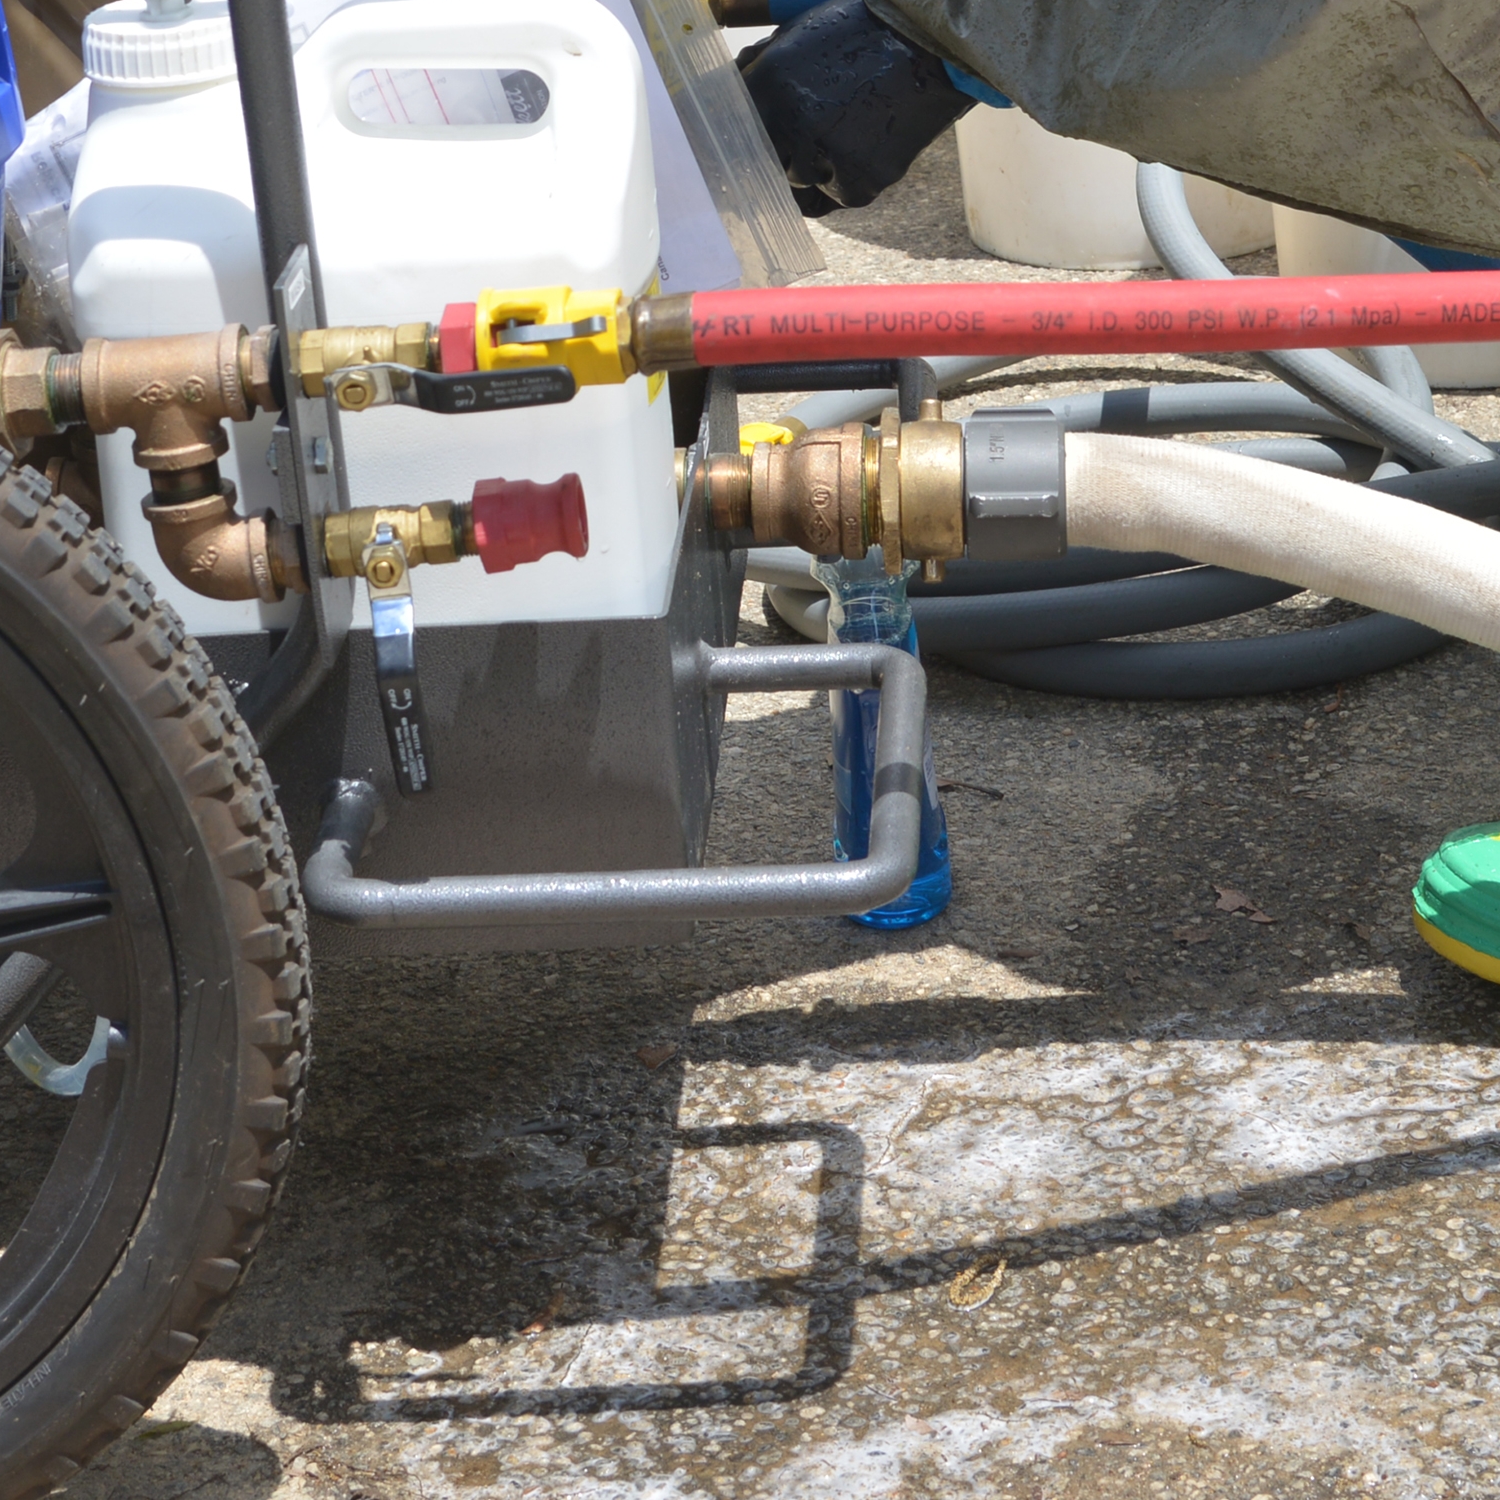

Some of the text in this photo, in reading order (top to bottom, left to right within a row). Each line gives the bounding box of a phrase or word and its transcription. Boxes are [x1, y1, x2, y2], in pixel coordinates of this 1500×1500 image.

[722, 314, 755, 338] RT
[769, 310, 987, 336] MULTI-PURPOSE
[1134, 309, 1174, 332] 300
[1187, 308, 1224, 331] PSI
